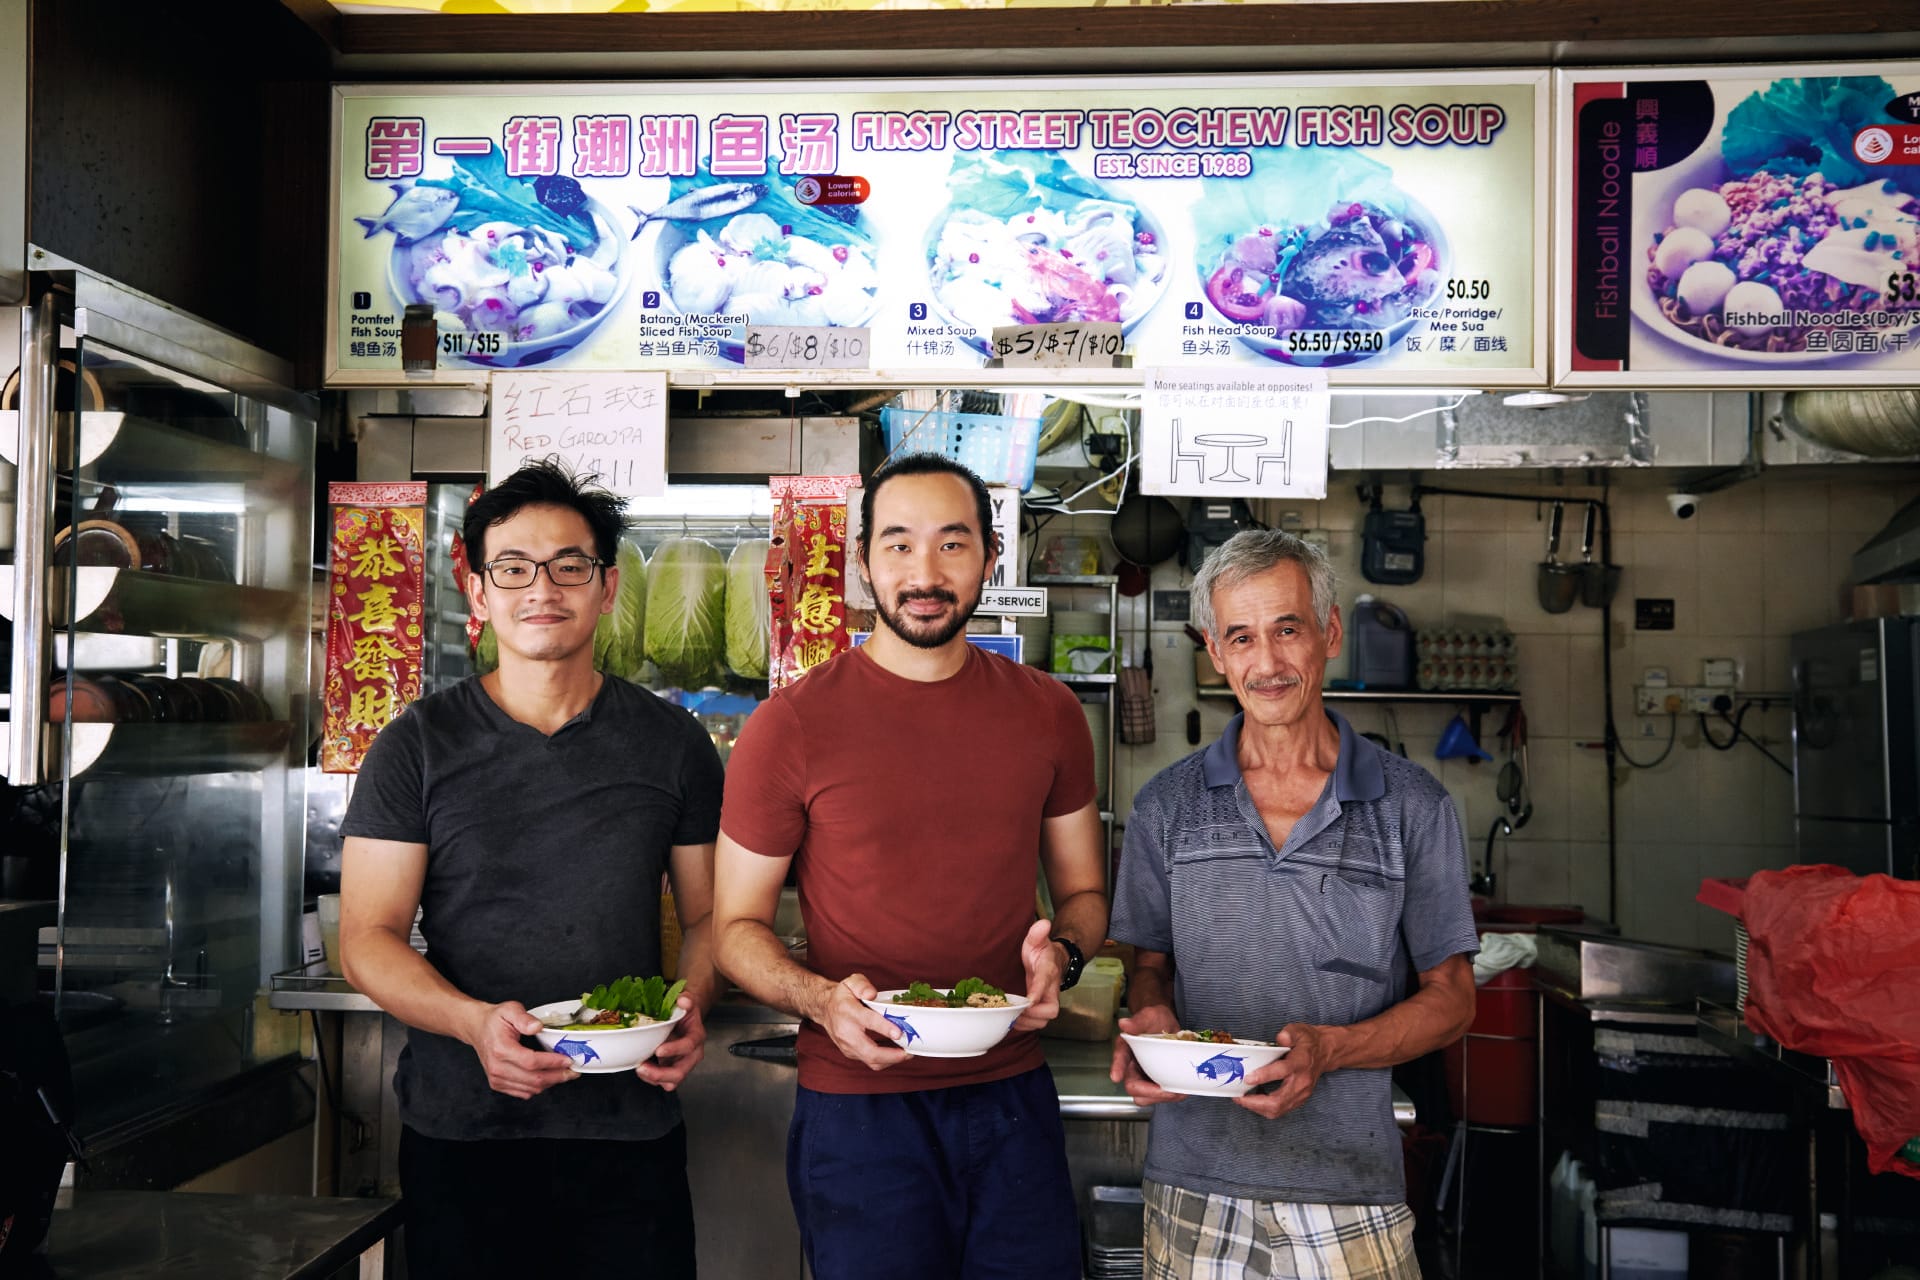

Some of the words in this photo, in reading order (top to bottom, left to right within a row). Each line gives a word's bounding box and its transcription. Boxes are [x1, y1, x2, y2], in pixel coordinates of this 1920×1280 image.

[845, 113, 948, 148] FIRST
[956, 112, 1083, 147] STREET
[1089, 110, 1288, 146] TEOCHEW
[1297, 107, 1380, 145] FISH
[1391, 105, 1503, 144] SOUP
[368, 115, 837, 177] 第一街潮洲鱼汤
[1098, 157, 1134, 175] EST.
[1139, 156, 1198, 175] SINCE
[1202, 156, 1248, 175] 1988
[1597, 121, 1621, 217] Noodle
[827, 182, 852, 190] Lower
[827, 190, 861, 198] calories
[1595, 227, 1620, 319] Fishball
[1447, 278, 1490, 300] $0.50
[351, 315, 394, 325] Pomfret
[640, 314, 681, 326] Batang
[684, 313, 750, 326] (Mackerel)
[1412, 308, 1503, 320] Rice/Porridge/
[1725, 311, 1790, 326] Fishball
[351, 327, 372, 337] Fish
[375, 327, 403, 340] Soup
[640, 327, 675, 337] Sliced
[678, 327, 700, 337] Fish
[703, 327, 732, 340] Soup
[907, 326, 943, 336] Mixed
[947, 326, 977, 338] Soup
[1183, 326, 1204, 335] Fish
[1208, 326, 1241, 335] Head
[1245, 326, 1275, 338] Soup
[1430, 322, 1458, 331] Mee
[1462, 322, 1484, 331] Sua
[350, 341, 397, 357] 鲳鱼汤
[443, 333, 463, 356] $11
[477, 333, 500, 356] $15
[906, 340, 955, 356] 什锦汤
[1182, 340, 1231, 355] 鱼头汤
[1154, 380, 1177, 391] More
[1179, 380, 1215, 394] seatings
[1217, 380, 1254, 392] available
[1257, 382, 1265, 392] at
[1268, 382, 1313, 394] opposites!
[559, 426, 643, 449] GAROUPA
[979, 596, 1041, 608] LF-SERVICE
[343, 534, 408, 731] 恭喜發財
